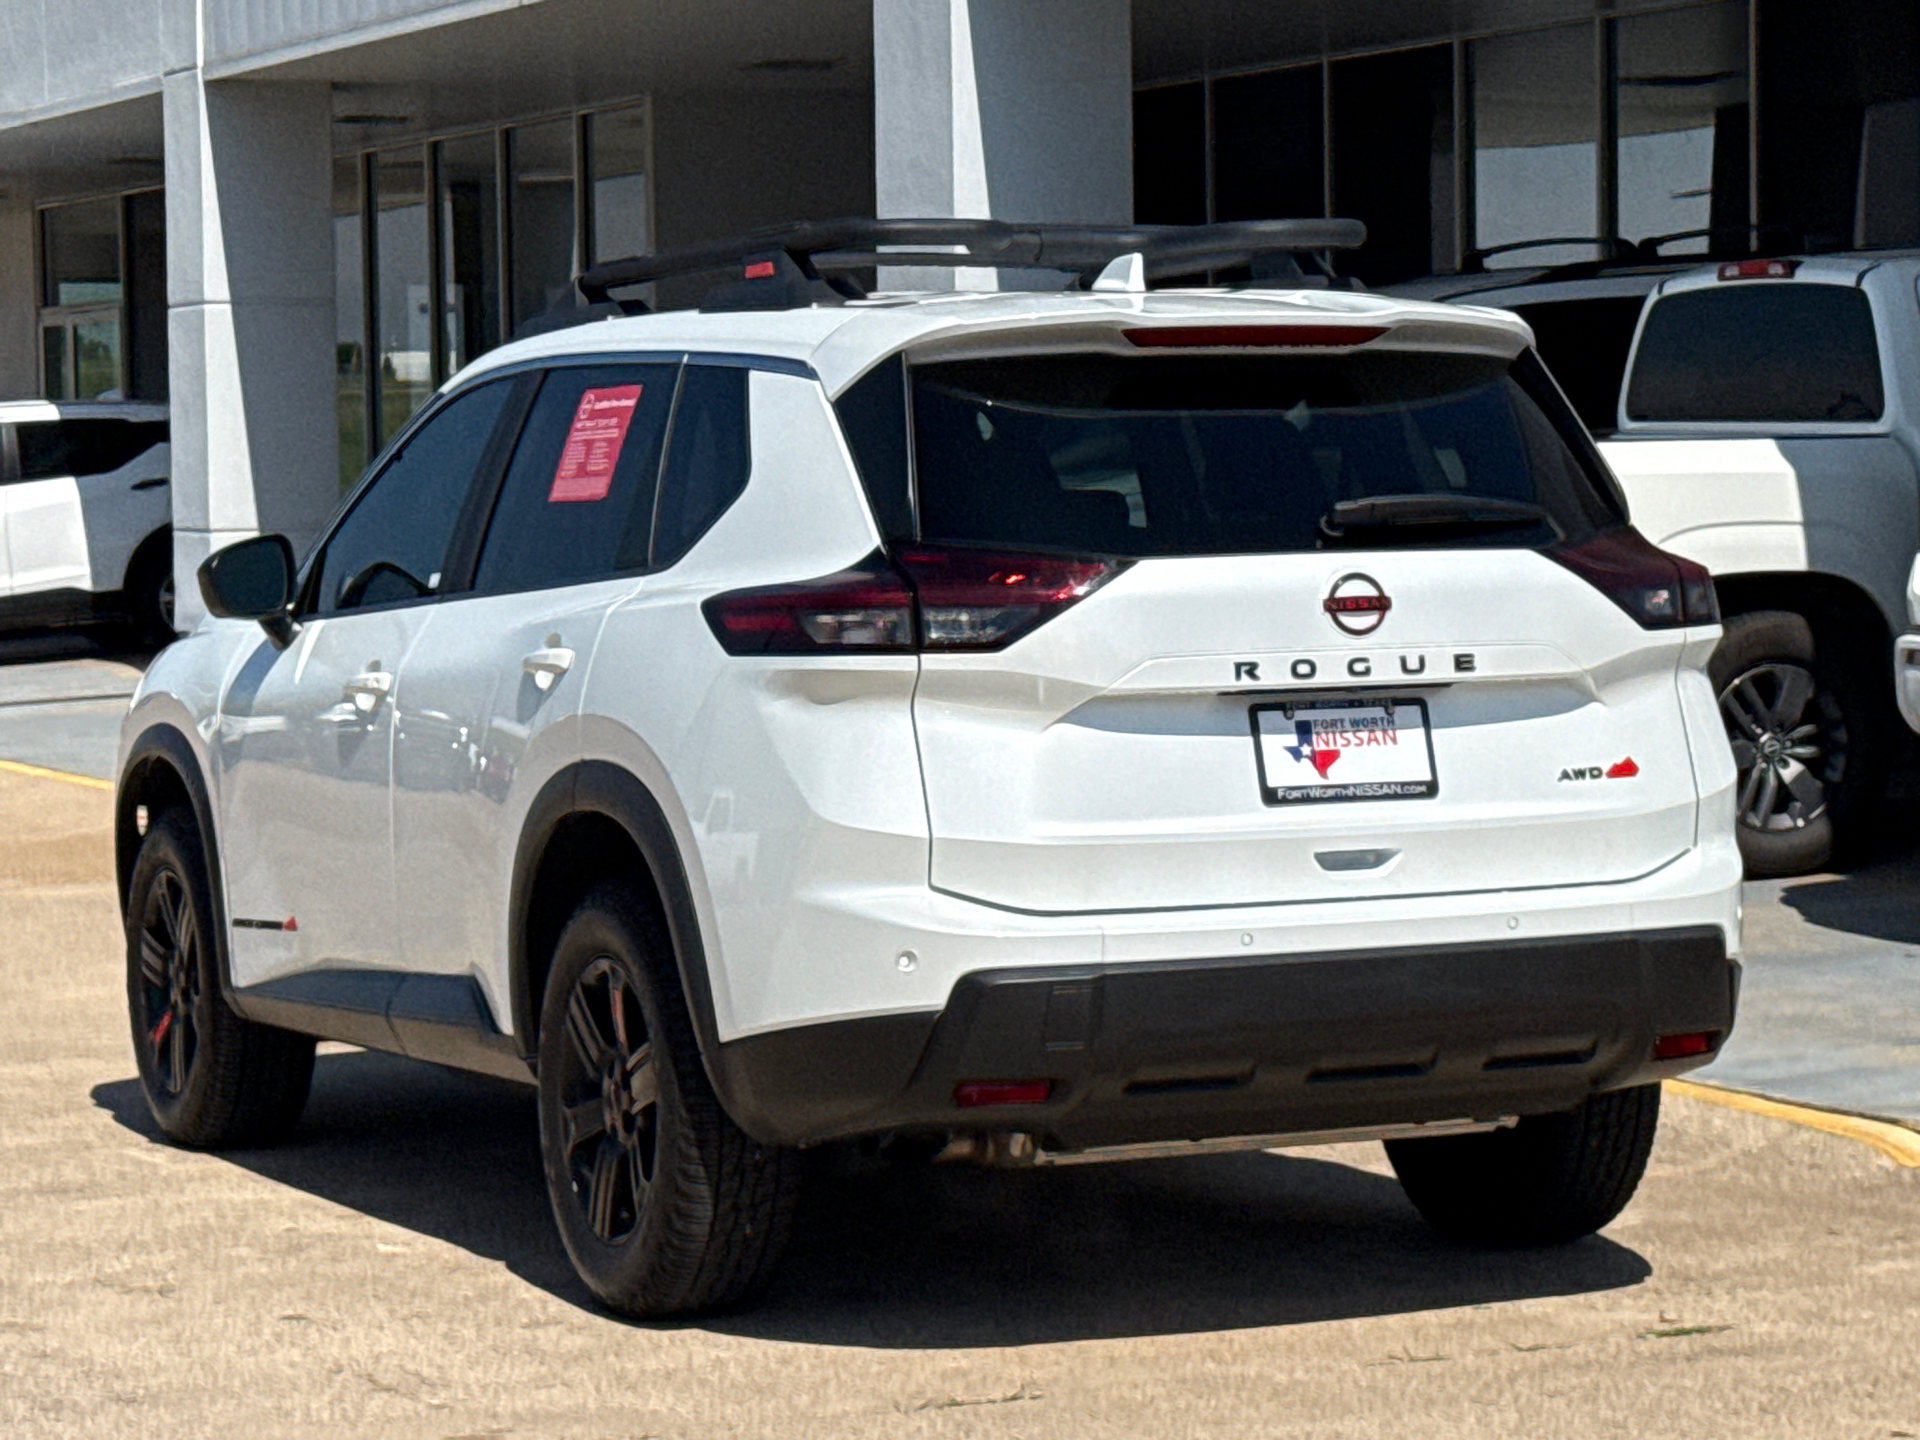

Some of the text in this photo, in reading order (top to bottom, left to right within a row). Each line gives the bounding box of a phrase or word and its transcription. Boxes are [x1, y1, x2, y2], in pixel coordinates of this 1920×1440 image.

[1326, 598, 1389, 610] NISSAN
[1233, 653, 1477, 682] ROGUE
[1313, 716, 1396, 730] FORT WORTH
[1314, 729, 1398, 747] NISSAN
[1557, 766, 1603, 782] AWD
